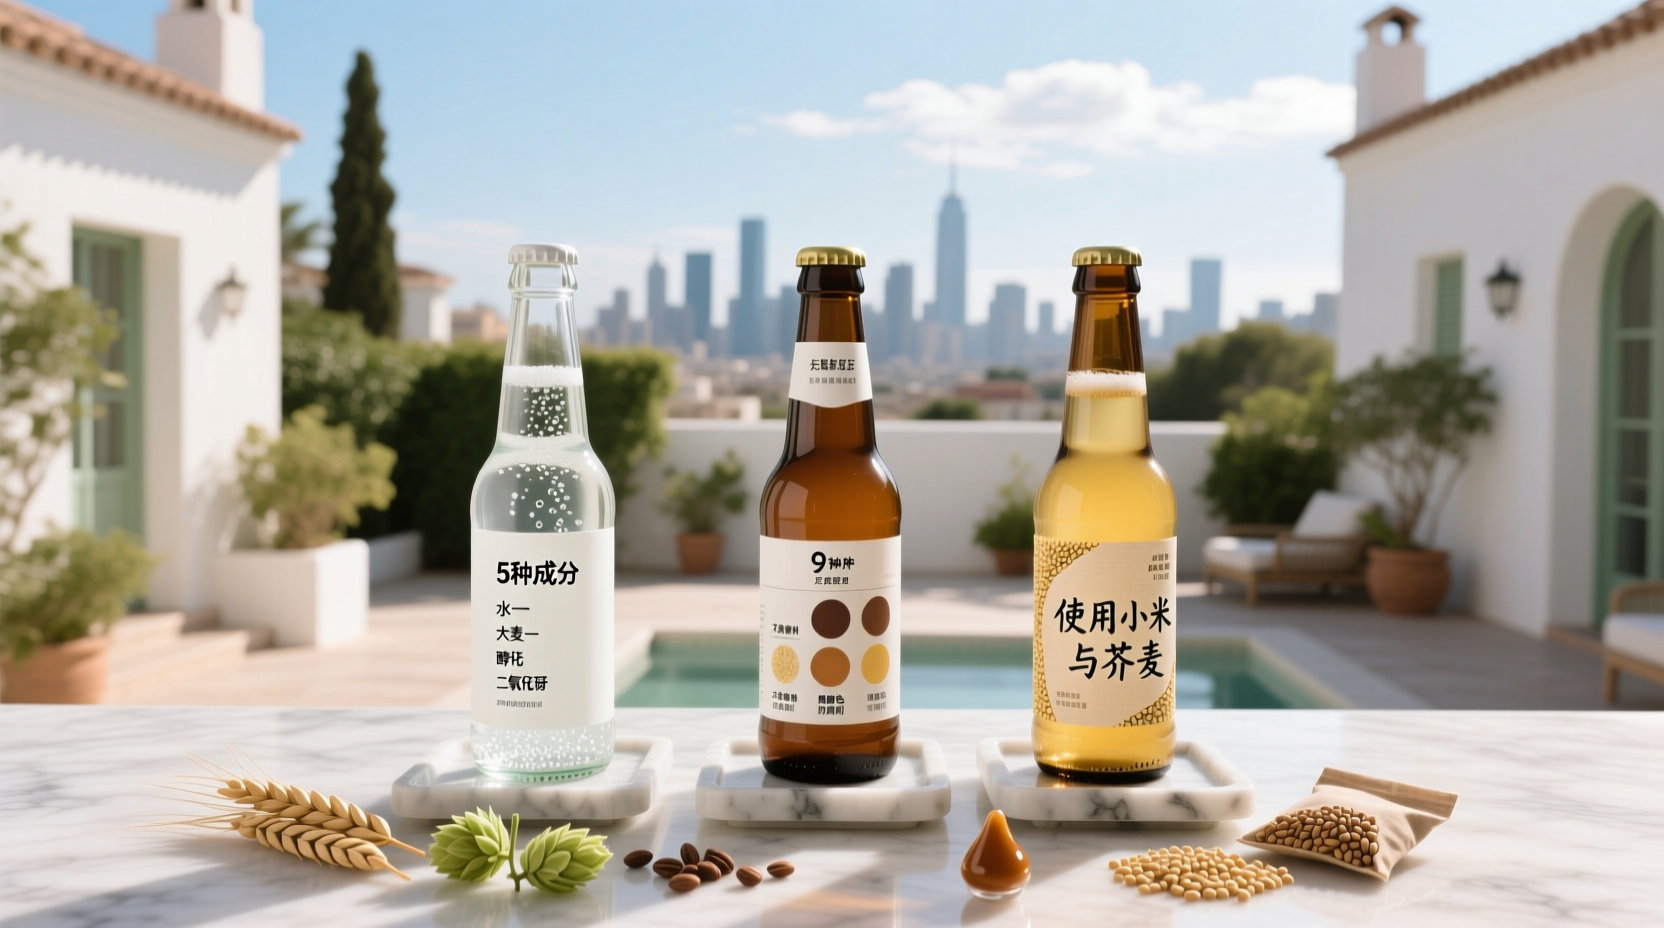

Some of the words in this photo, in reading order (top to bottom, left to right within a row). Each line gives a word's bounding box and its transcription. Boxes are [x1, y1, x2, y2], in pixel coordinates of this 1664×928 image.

[496, 560, 579, 586] 5种成分
[1054, 596, 1171, 634] 使用小米
[1068, 639, 1164, 681] 与芥麦
